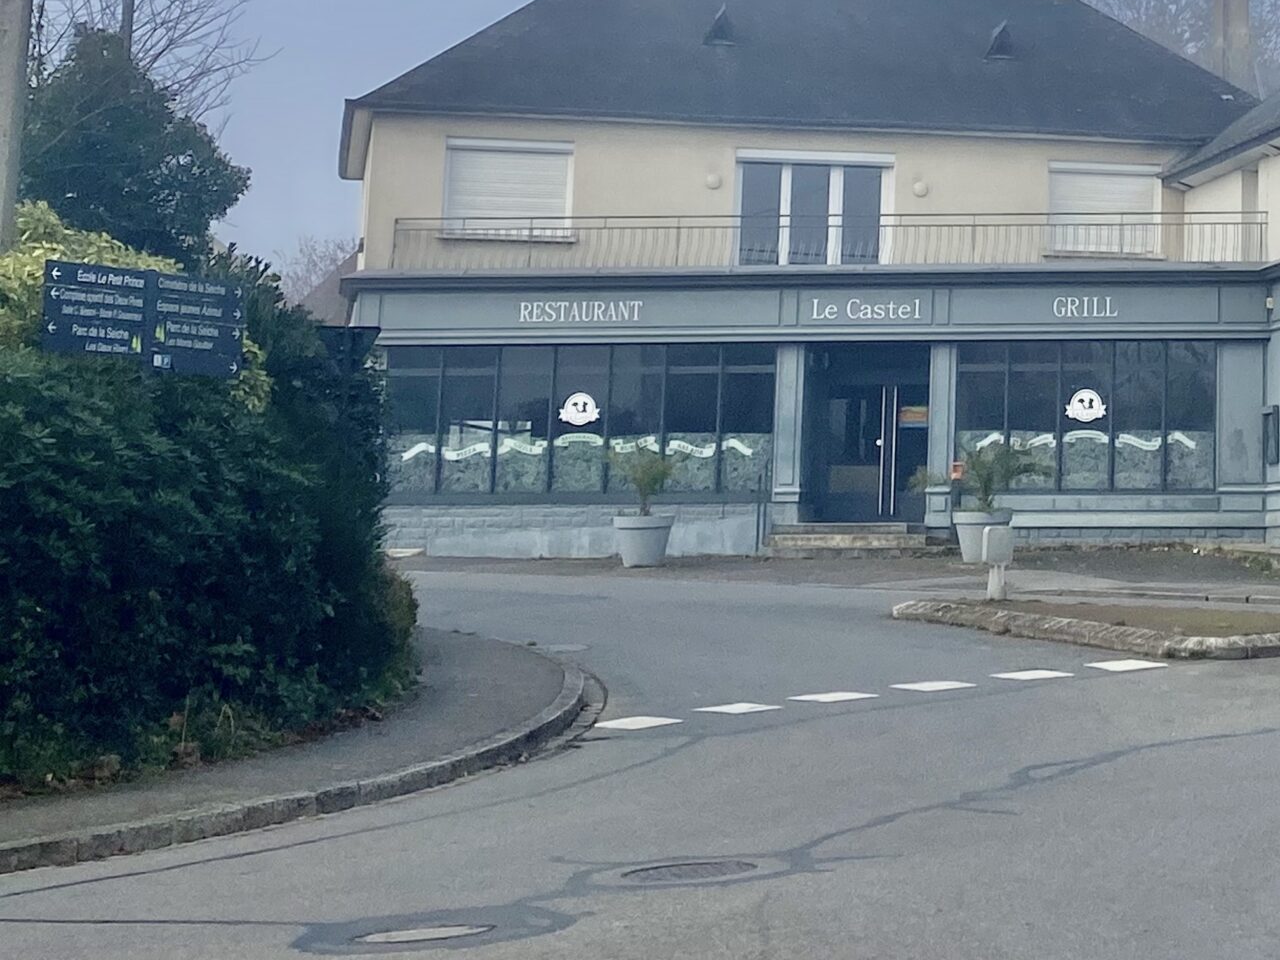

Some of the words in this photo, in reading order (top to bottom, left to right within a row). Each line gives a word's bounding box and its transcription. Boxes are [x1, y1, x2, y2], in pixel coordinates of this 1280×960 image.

[519, 300, 643, 323] RESTAURANT
[812, 298, 838, 320] Le
[847, 298, 921, 320] Castel
[1053, 296, 1118, 318] GRILL
[72, 324, 88, 336] Parc
